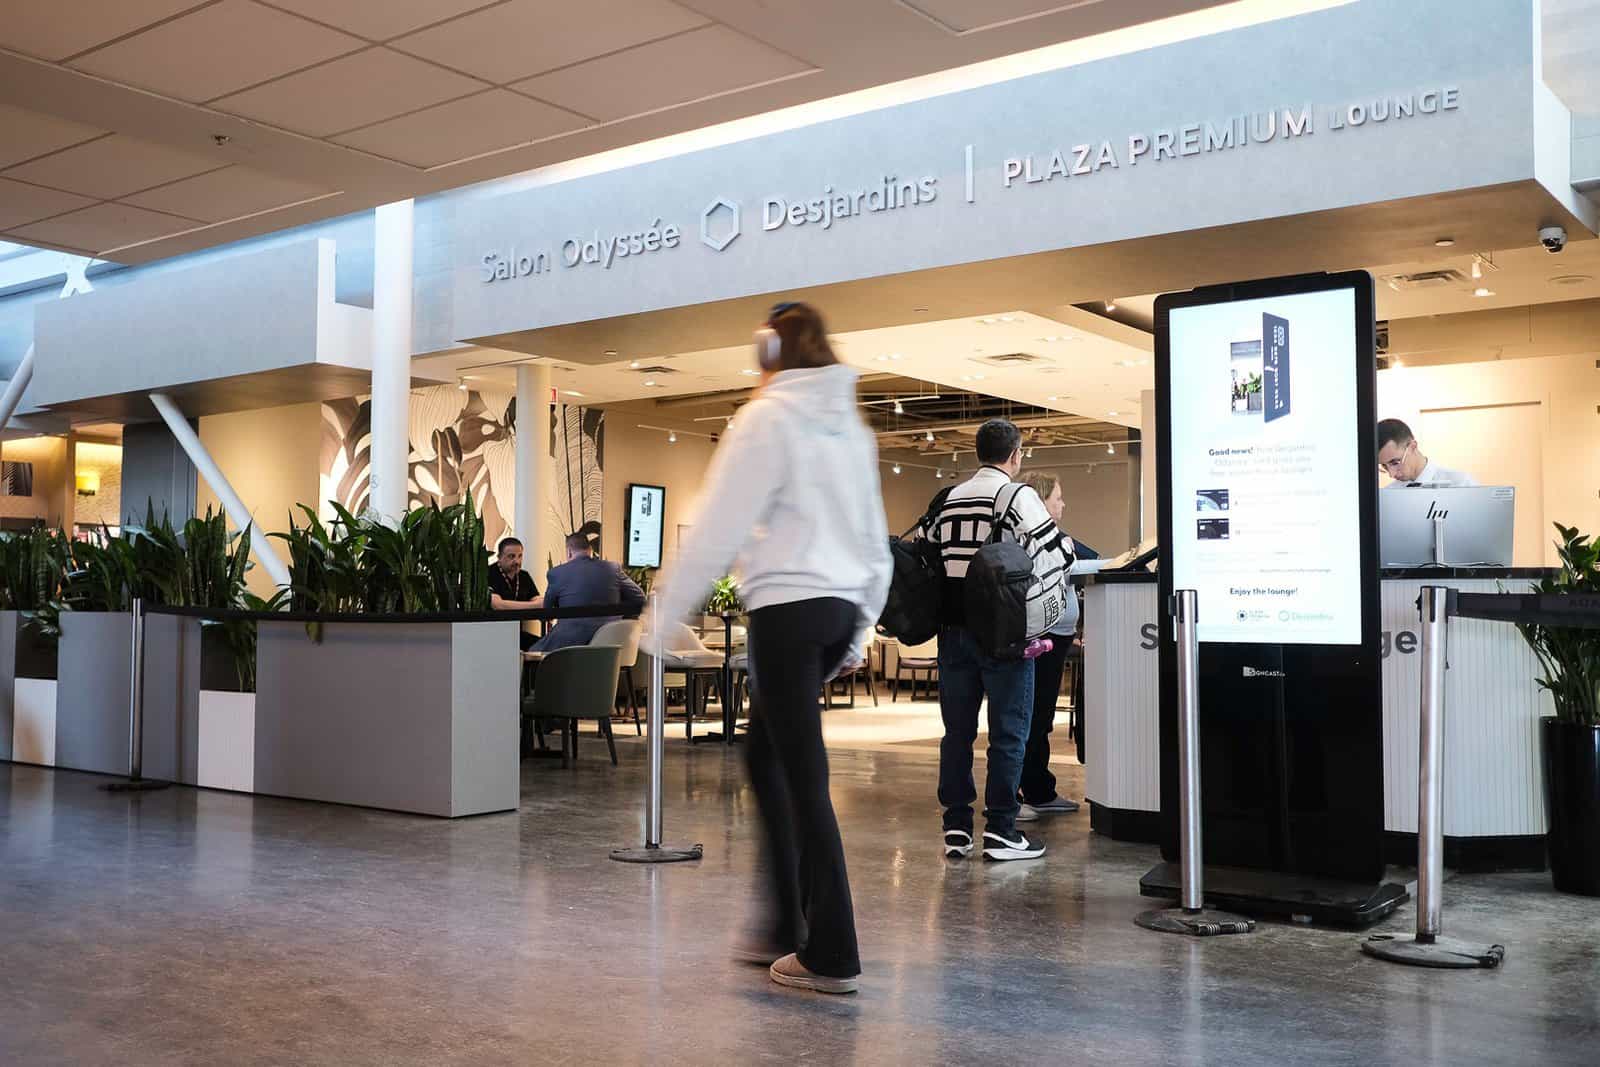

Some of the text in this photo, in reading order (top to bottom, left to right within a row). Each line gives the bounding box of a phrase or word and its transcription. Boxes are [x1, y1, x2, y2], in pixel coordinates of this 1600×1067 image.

[1002, 87, 1460, 187] PLAZA PREMIUM LOUNGE
[480, 175, 937, 283] Salon Odyssée Desjardins
[1230, 587, 1251, 596] Enjoy
[1252, 587, 1266, 595] the
